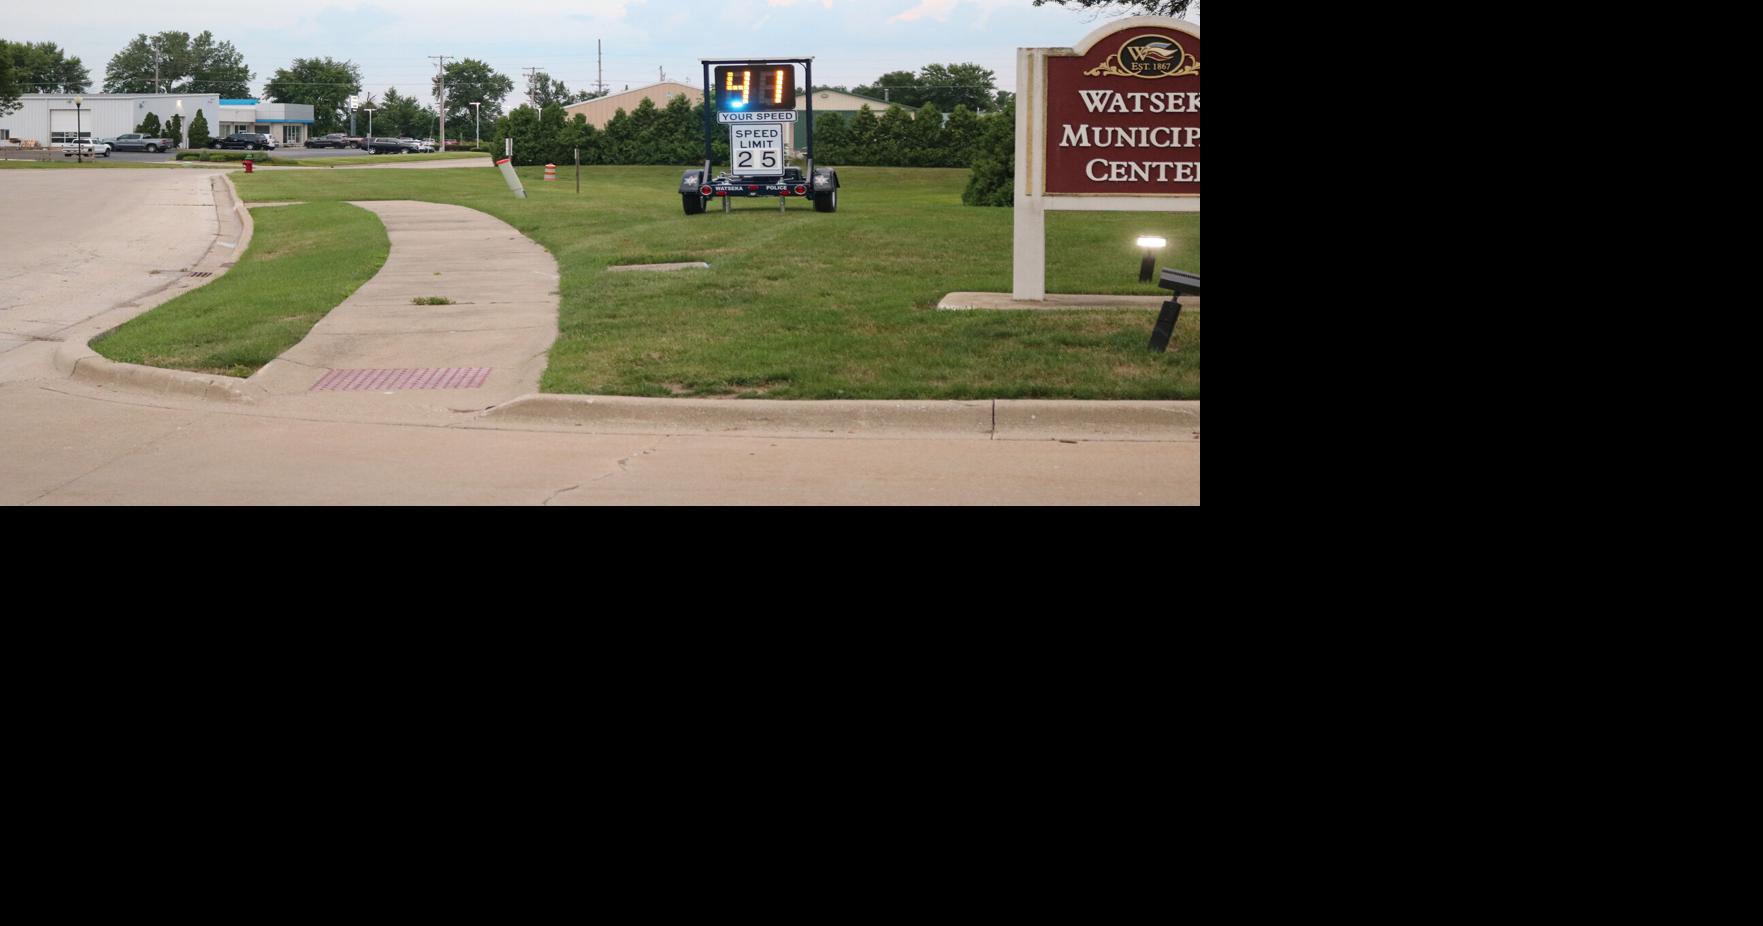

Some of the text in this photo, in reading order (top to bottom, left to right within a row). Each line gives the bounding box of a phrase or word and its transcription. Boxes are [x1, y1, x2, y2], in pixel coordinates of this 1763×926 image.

[1153, 62, 1171, 71] 1867
[726, 70, 784, 104] 41
[722, 112, 793, 121] YOUR SPEED
[735, 129, 778, 138] SPEED
[1059, 124, 1200, 148] MUNICIP
[740, 140, 773, 149] LIMIT
[738, 151, 776, 168] 25
